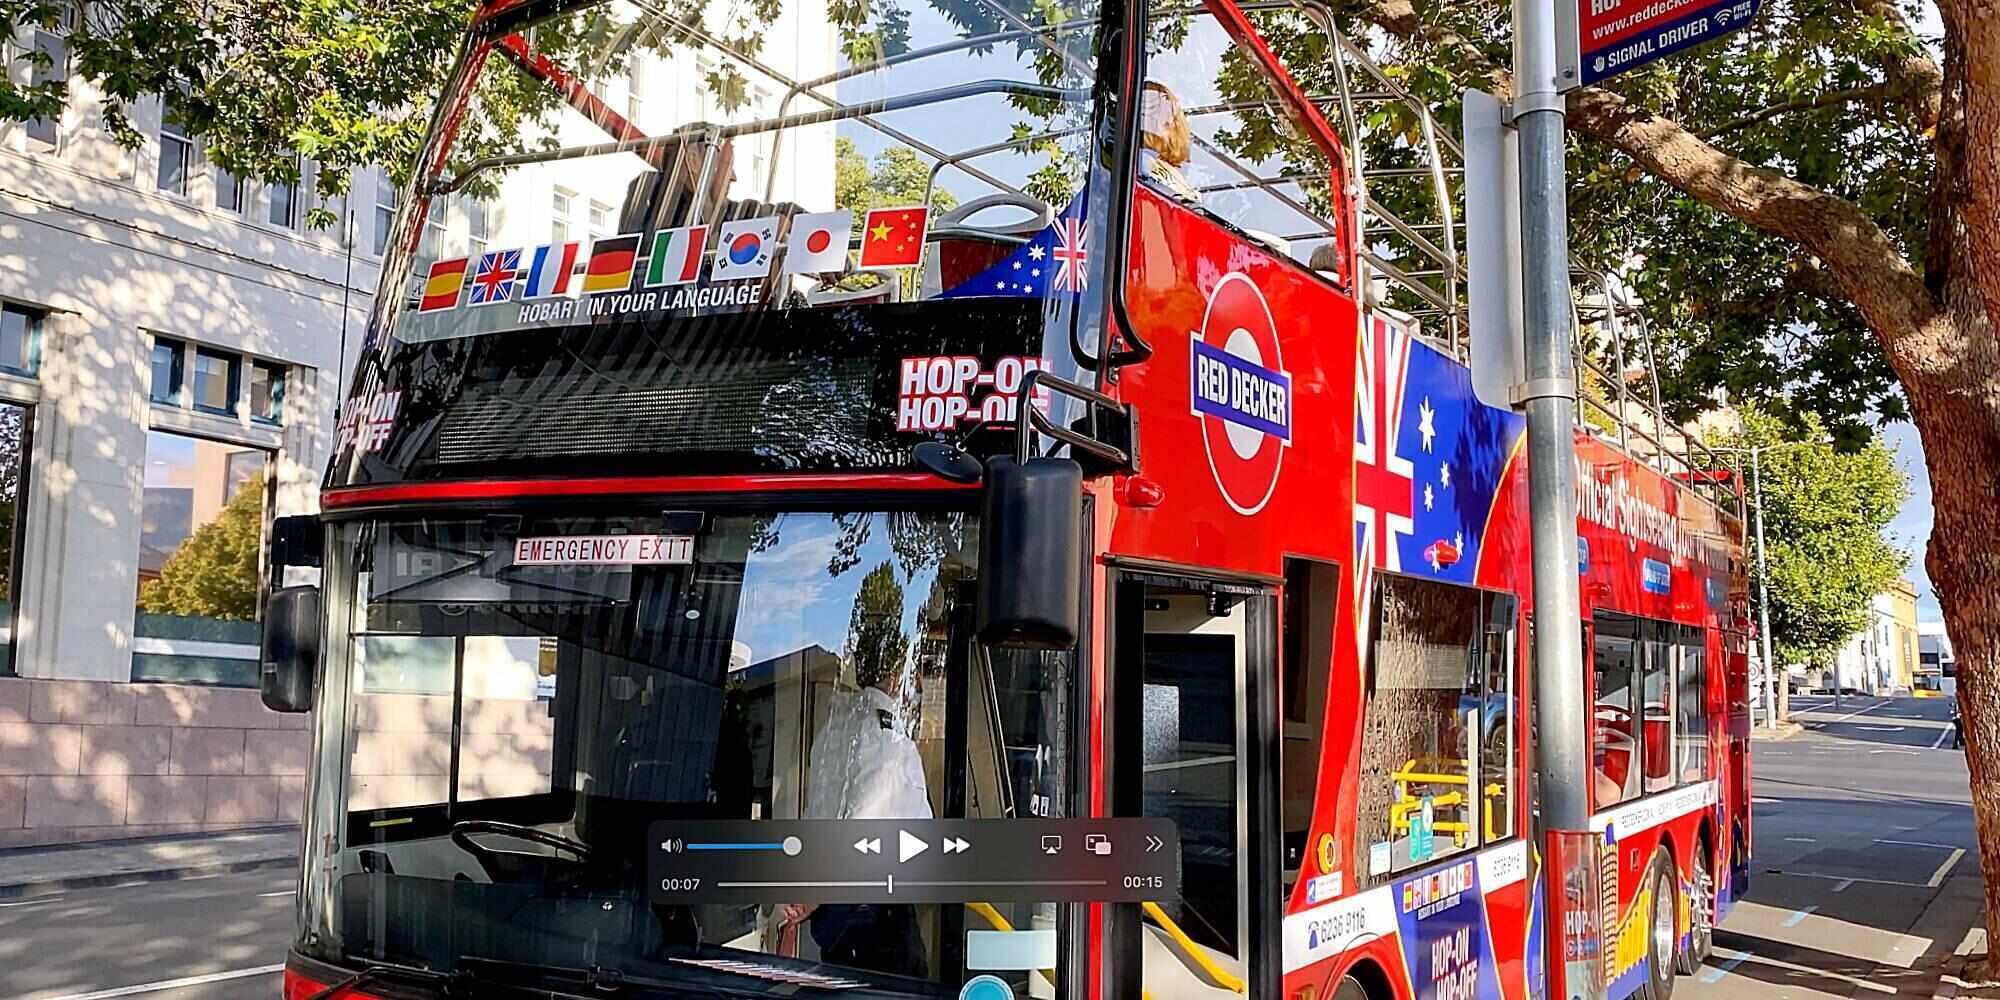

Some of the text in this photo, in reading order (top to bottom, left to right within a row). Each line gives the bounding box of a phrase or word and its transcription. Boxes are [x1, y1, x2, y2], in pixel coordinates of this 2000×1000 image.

[1608, 18, 1709, 68] SIGNAL DRIVER
[517, 299, 582, 324] HOBART
[609, 292, 655, 315] YOUR
[661, 284, 762, 311] LANGUAGE
[336, 391, 401, 430] OP-ON
[1198, 354, 1286, 426] RED DECKER
[1618, 472, 1678, 567] Sightseeing
[518, 538, 691, 561] EMERGENCY EXIT
[1321, 907, 1365, 943] 6236 9116
[1431, 925, 1470, 980] HOP-ON
